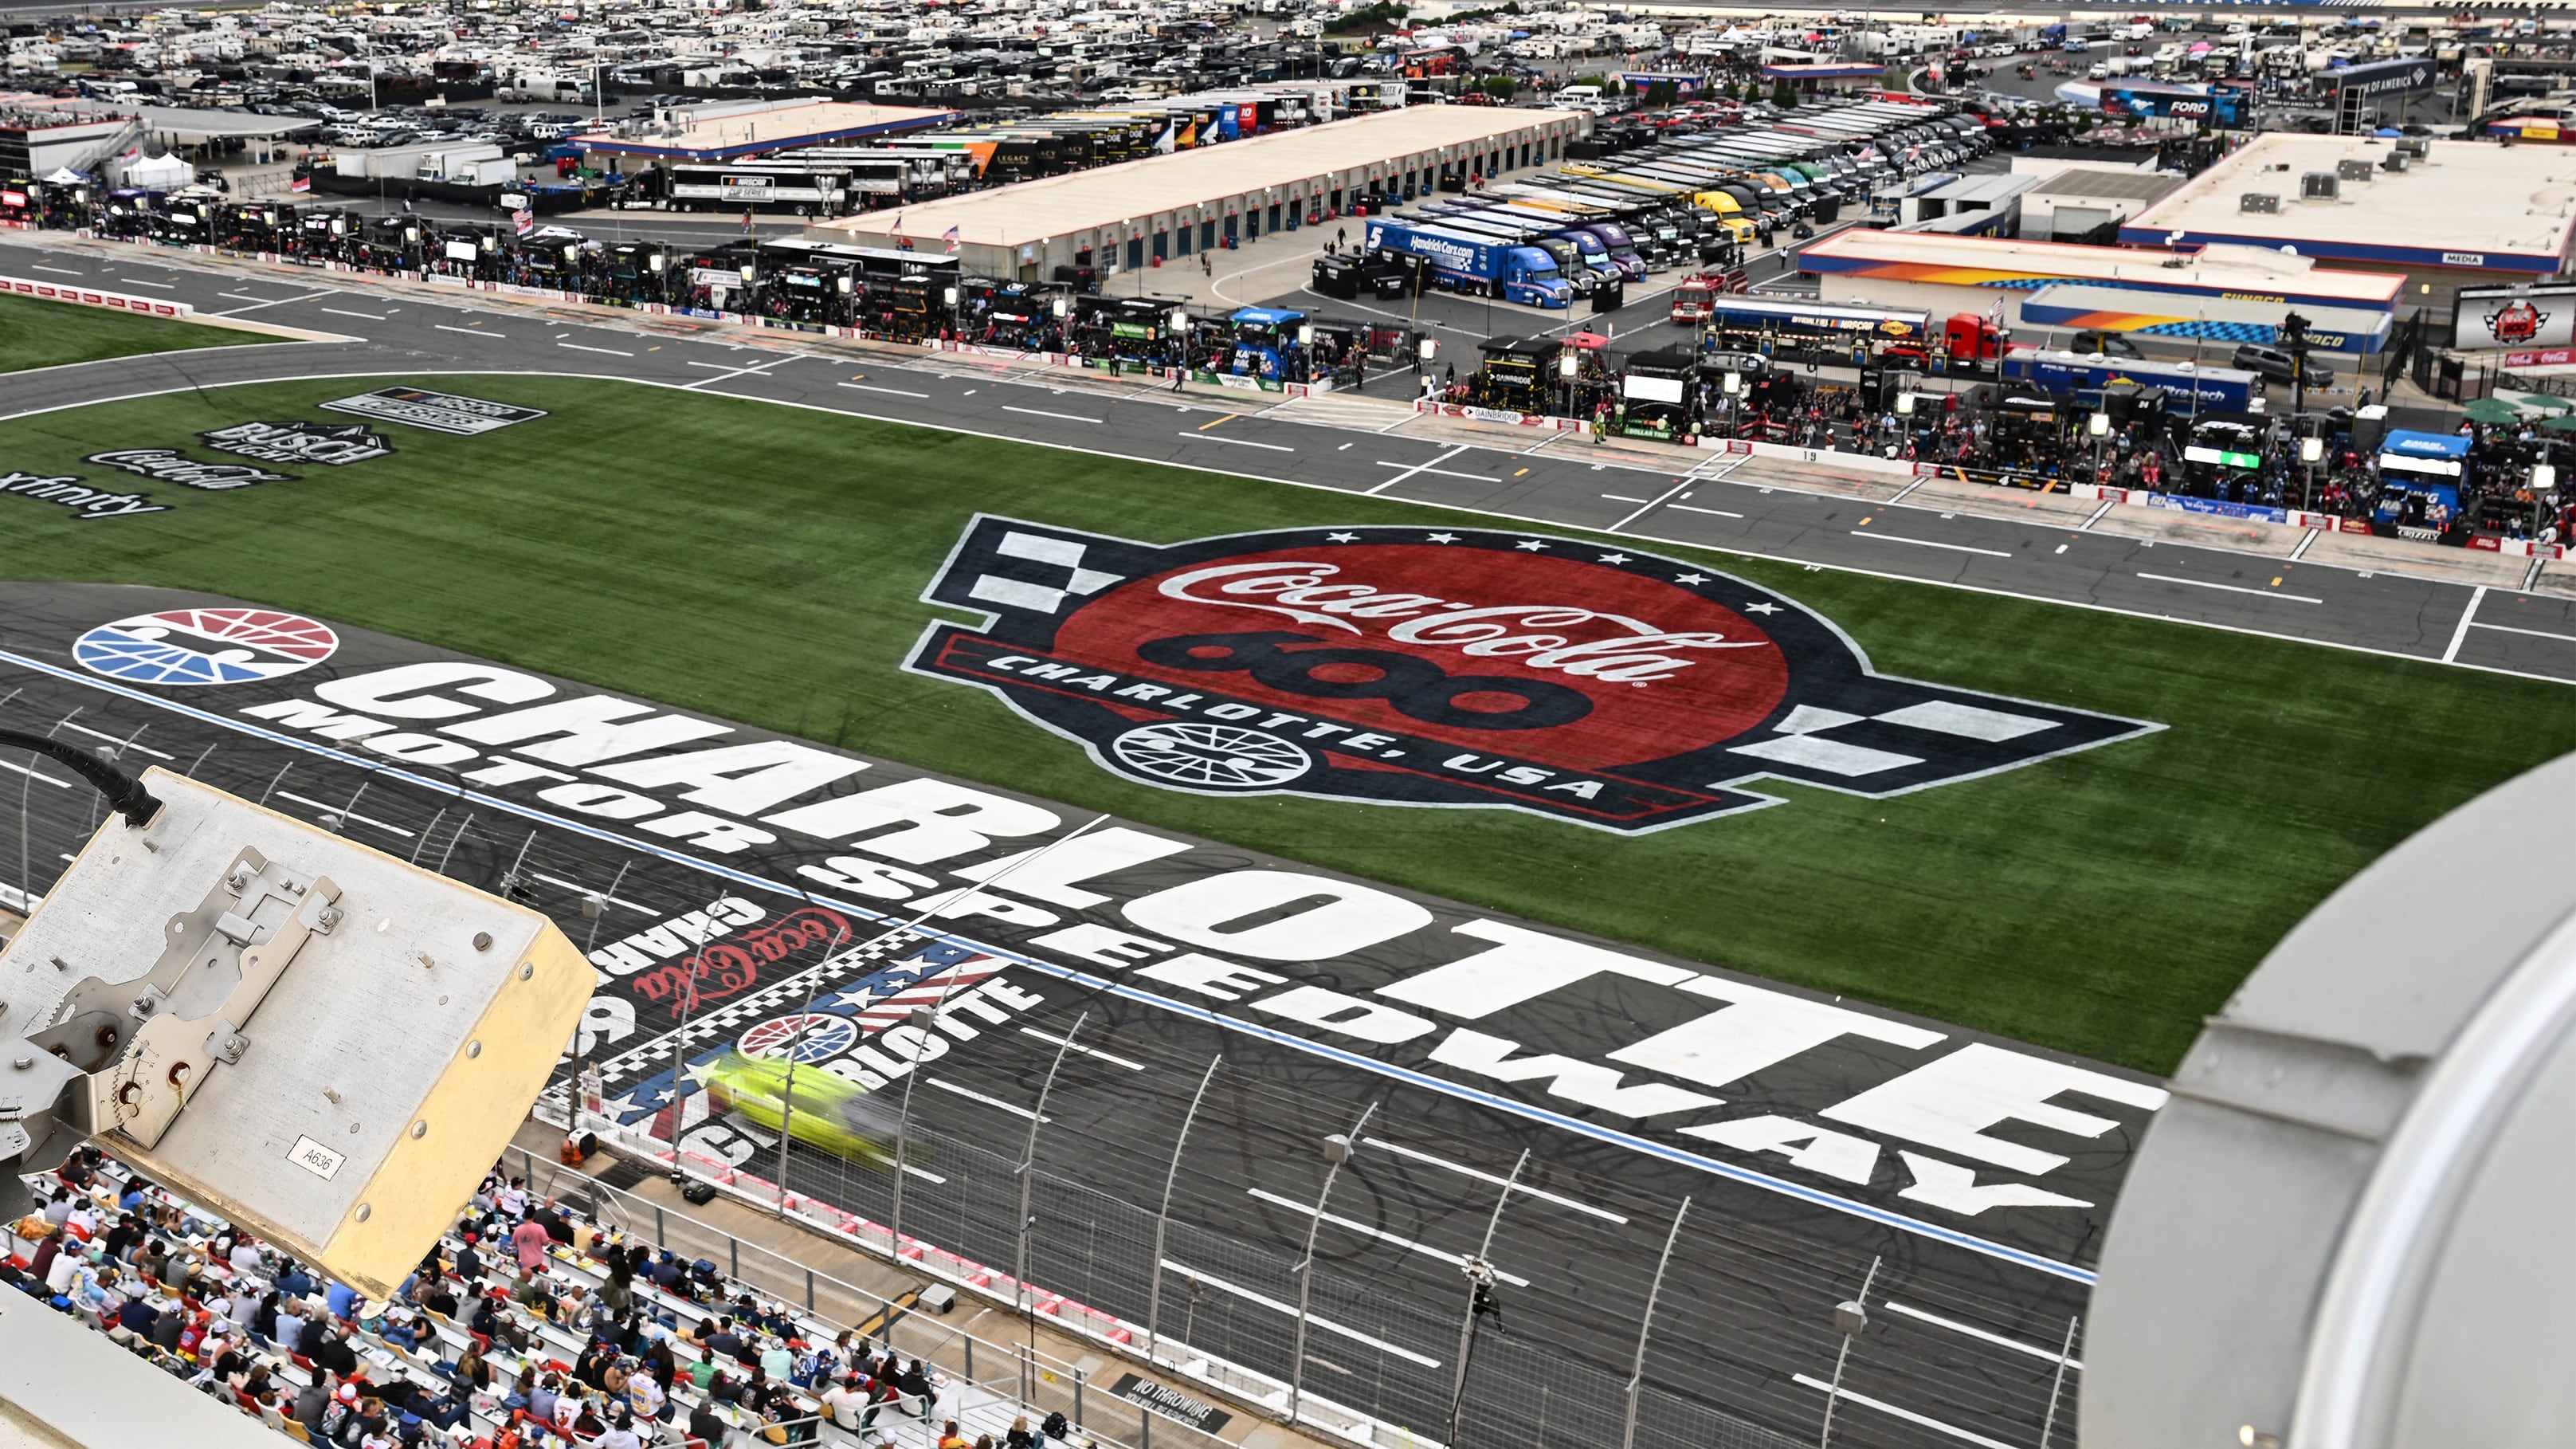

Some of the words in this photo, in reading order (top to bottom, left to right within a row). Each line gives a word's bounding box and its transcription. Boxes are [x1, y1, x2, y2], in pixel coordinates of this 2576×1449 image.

[2380, 76, 2412, 90] AMERICA
[2170, 100, 2209, 114] FORD
[997, 155, 1031, 163] LEGACY
[727, 188, 742, 197] CUP
[738, 178, 767, 187] NASCAR
[1368, 226, 1384, 249] 5
[2447, 254, 2479, 264] MEDIA
[1841, 320, 1875, 331] NASCAR
[1495, 372, 1532, 386] GAINBRIDGE
[1474, 409, 1519, 422] GAINBRIDGE
[209, 422, 391, 466] BUSCH
[1628, 427, 1653, 438] DOLLAR
[1653, 430, 1671, 439] TREE
[207, 440, 304, 464] LIGHT
[88, 449, 299, 491] Coca-Cola
[0, 472, 167, 519] xfinity
[2397, 528, 2440, 541] GRIZZLY
[1158, 561, 1769, 681] Coca-Cola
[1136, 630, 1594, 731] 600
[986, 654, 1406, 759] CHARLOTTE,
[1442, 753, 1606, 800] USA
[314, 662, 2170, 1176] CHARLOTTE
[238, 698, 777, 853] MOTOR
[797, 856, 2095, 1216] SPEEDWAY
[633, 906, 853, 1019] Coca-Cola
[302, 1149, 333, 1171] A636
[1124, 1392, 1141, 1405] YOU
[1139, 1397, 1156, 1410] WILL
[1155, 1405, 1167, 1415] BE
[1131, 1378, 1156, 1395] NO
[1151, 1385, 1214, 1420] THROWING
